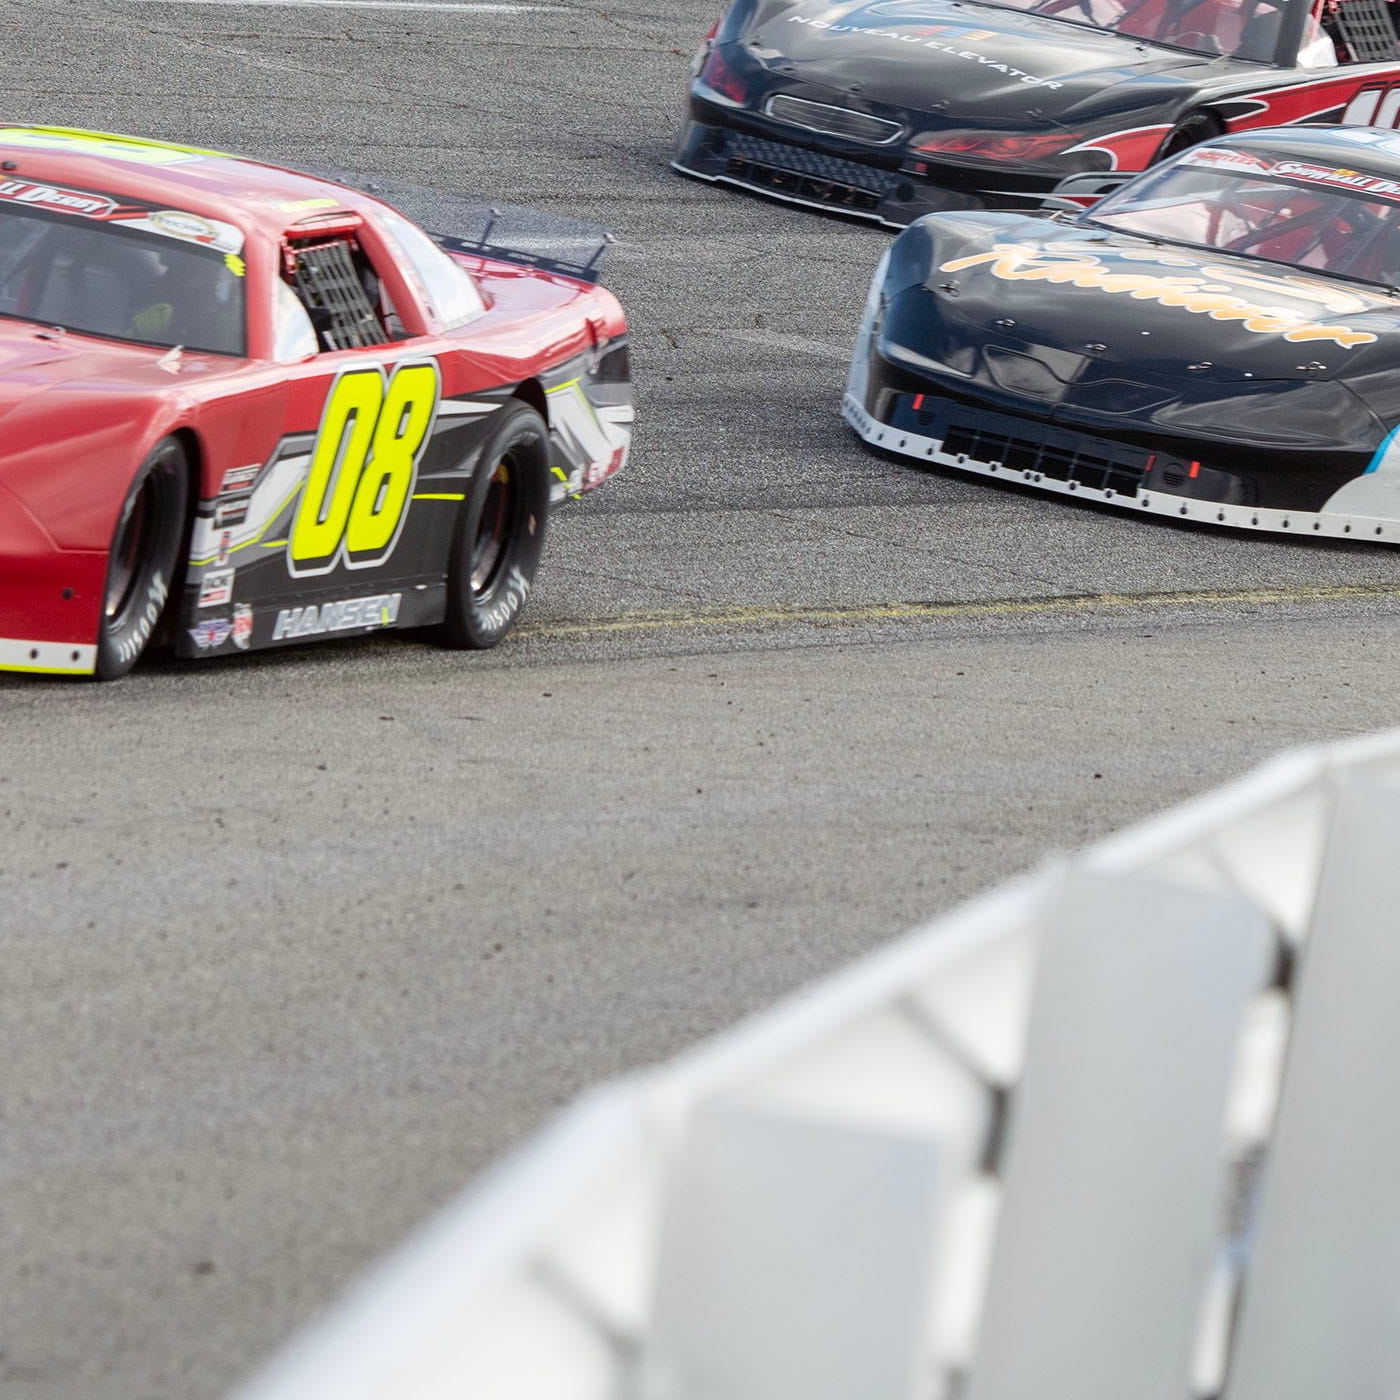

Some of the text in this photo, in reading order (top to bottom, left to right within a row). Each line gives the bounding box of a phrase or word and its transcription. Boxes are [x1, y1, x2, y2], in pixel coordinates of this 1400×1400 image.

[787, 15, 1065, 91] NOUVEAU ELEVATOR
[25, 183, 105, 215] DERBY
[1276, 162, 1371, 189] SNOWBALL
[289, 360, 439, 566] 08
[271, 592, 403, 641] HANSEN
